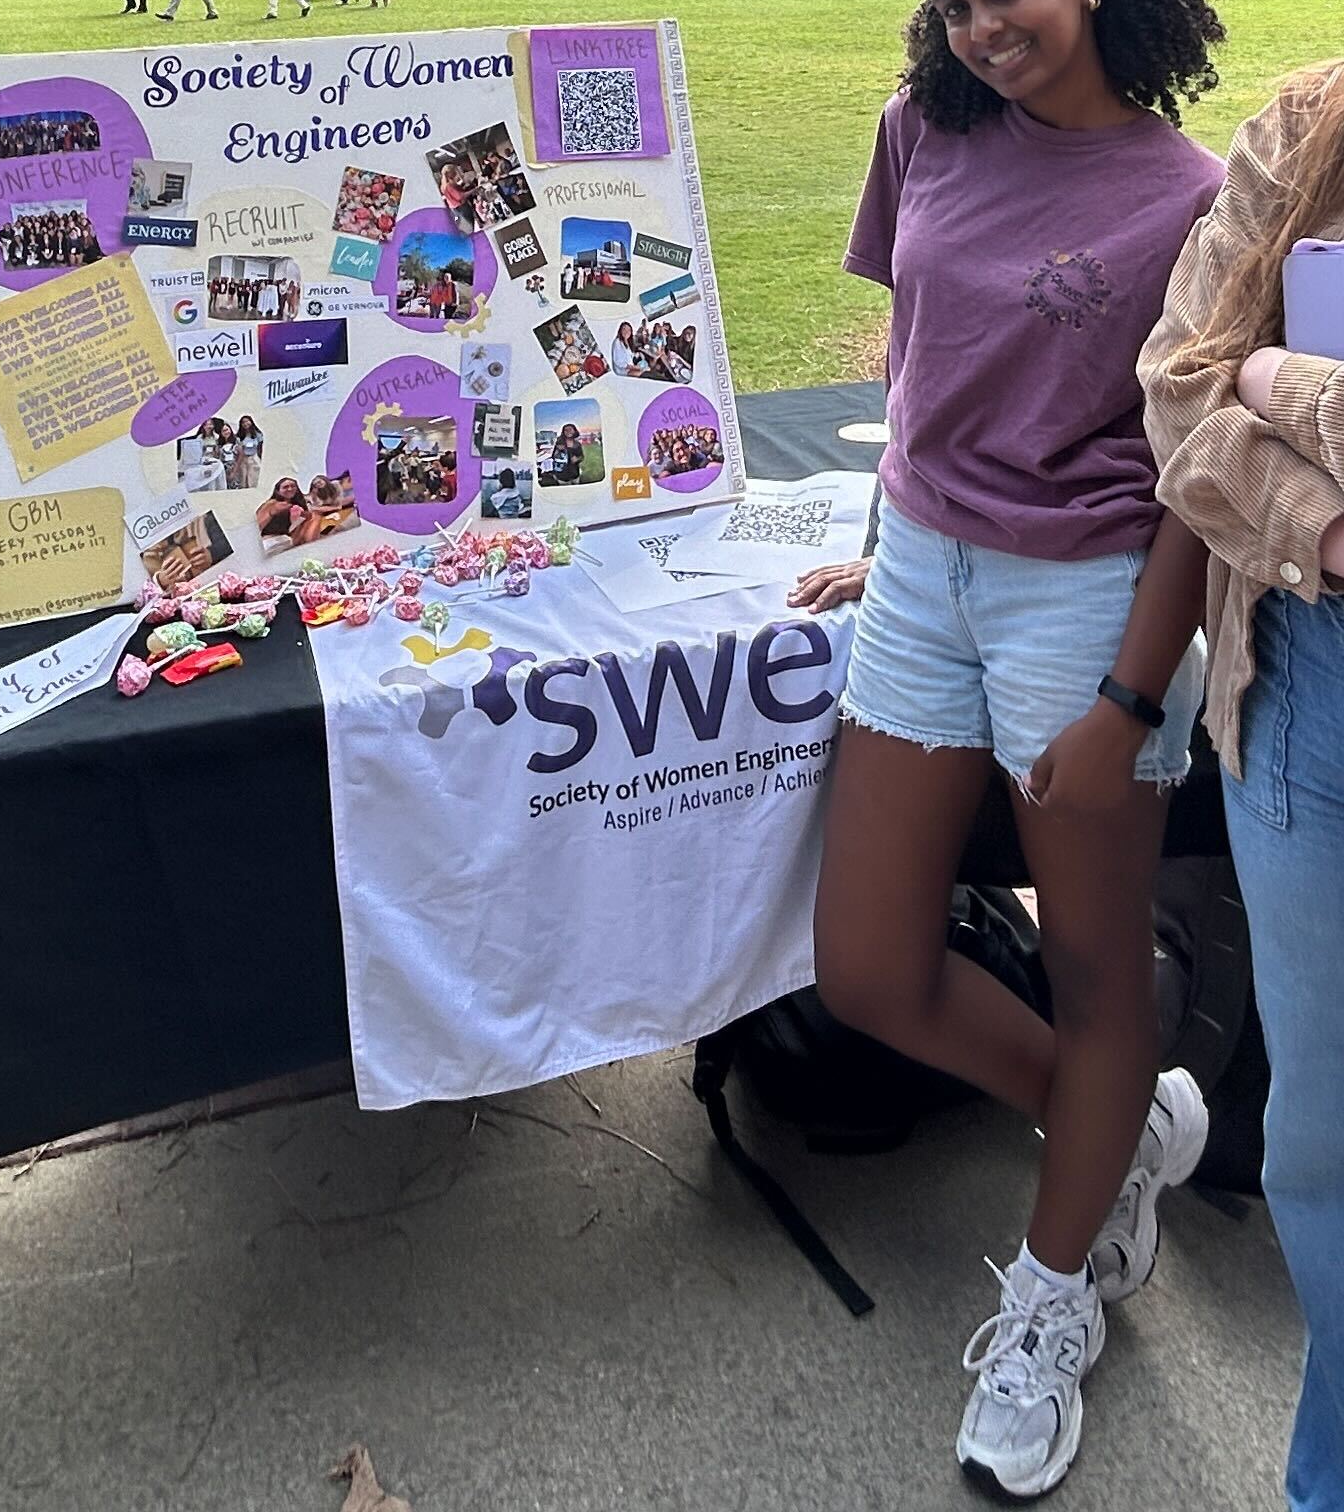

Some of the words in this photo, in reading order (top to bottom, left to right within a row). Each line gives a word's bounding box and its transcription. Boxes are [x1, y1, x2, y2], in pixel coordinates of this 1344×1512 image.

[546, 38, 649, 65] LINKTREE
[143, 53, 312, 107] Society
[319, 76, 350, 106] of
[347, 41, 514, 89] Women
[223, 112, 431, 164] Engineers
[543, 180, 646, 206] PROFESSIONAL
[206, 203, 305, 244] RECRUIT
[503, 234, 534, 254] GOING
[638, 239, 689, 264] STRENGTH
[506, 245, 538, 265] PLACES
[96, 276, 120, 294] ALL
[151, 275, 189, 288] TRUIST
[307, 285, 351, 297] micron
[101, 288, 124, 305] ALL
[344, 301, 385, 311] VERNOVA
[106, 299, 129, 316] ALL
[111, 312, 134, 329] ALL
[178, 329, 253, 362] newell
[126, 349, 150, 368] ALL
[131, 361, 155, 379] ALL
[136, 374, 160, 391] ALL
[266, 369, 329, 401] Milwaukee
[356, 366, 450, 407] OUTREACH
[170, 394, 208, 426] DEAN
[661, 403, 710, 424] SOCIAL
[615, 473, 645, 492] play
[8, 499, 63, 532] GBM
[33, 524, 96, 544] TUESDAY
[52, 541, 86, 555] FLAG
[90, 536, 106, 548] 117
[38, 649, 62, 669] of
[525, 619, 836, 774] swe
[528, 780, 609, 818] Society
[615, 775, 640, 801] of
[644, 760, 728, 794] Women
[603, 804, 662, 833] Aspire
[679, 780, 755, 813] Advance
